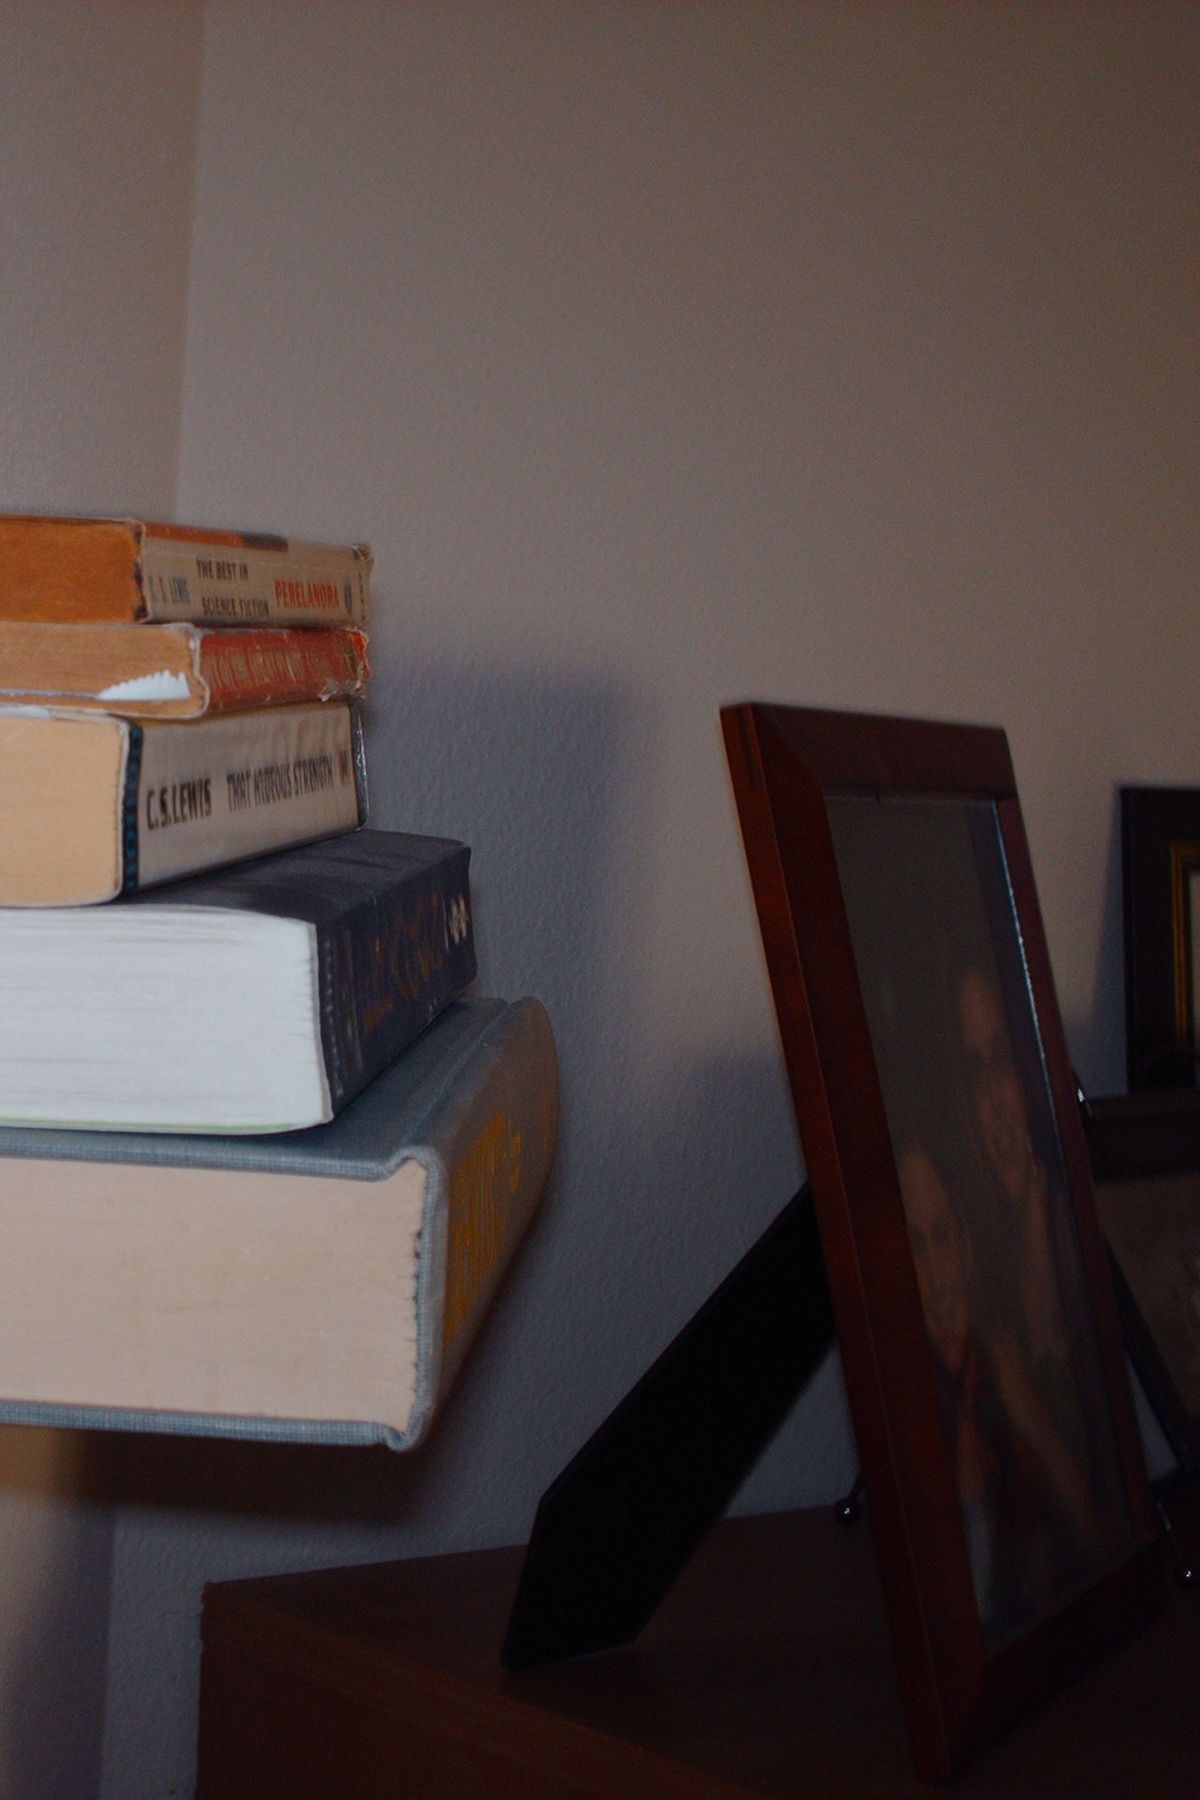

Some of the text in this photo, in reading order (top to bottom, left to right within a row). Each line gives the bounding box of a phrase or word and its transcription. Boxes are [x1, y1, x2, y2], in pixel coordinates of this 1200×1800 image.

[196, 559, 249, 581] THE BEST IN
[274, 580, 340, 609] PERELANDRA
[201, 597, 270, 618] SCIENCE FICTION
[226, 770, 252, 812] THAT
[253, 763, 292, 808] HIDEOUS
[293, 754, 334, 797] STRENGTH
